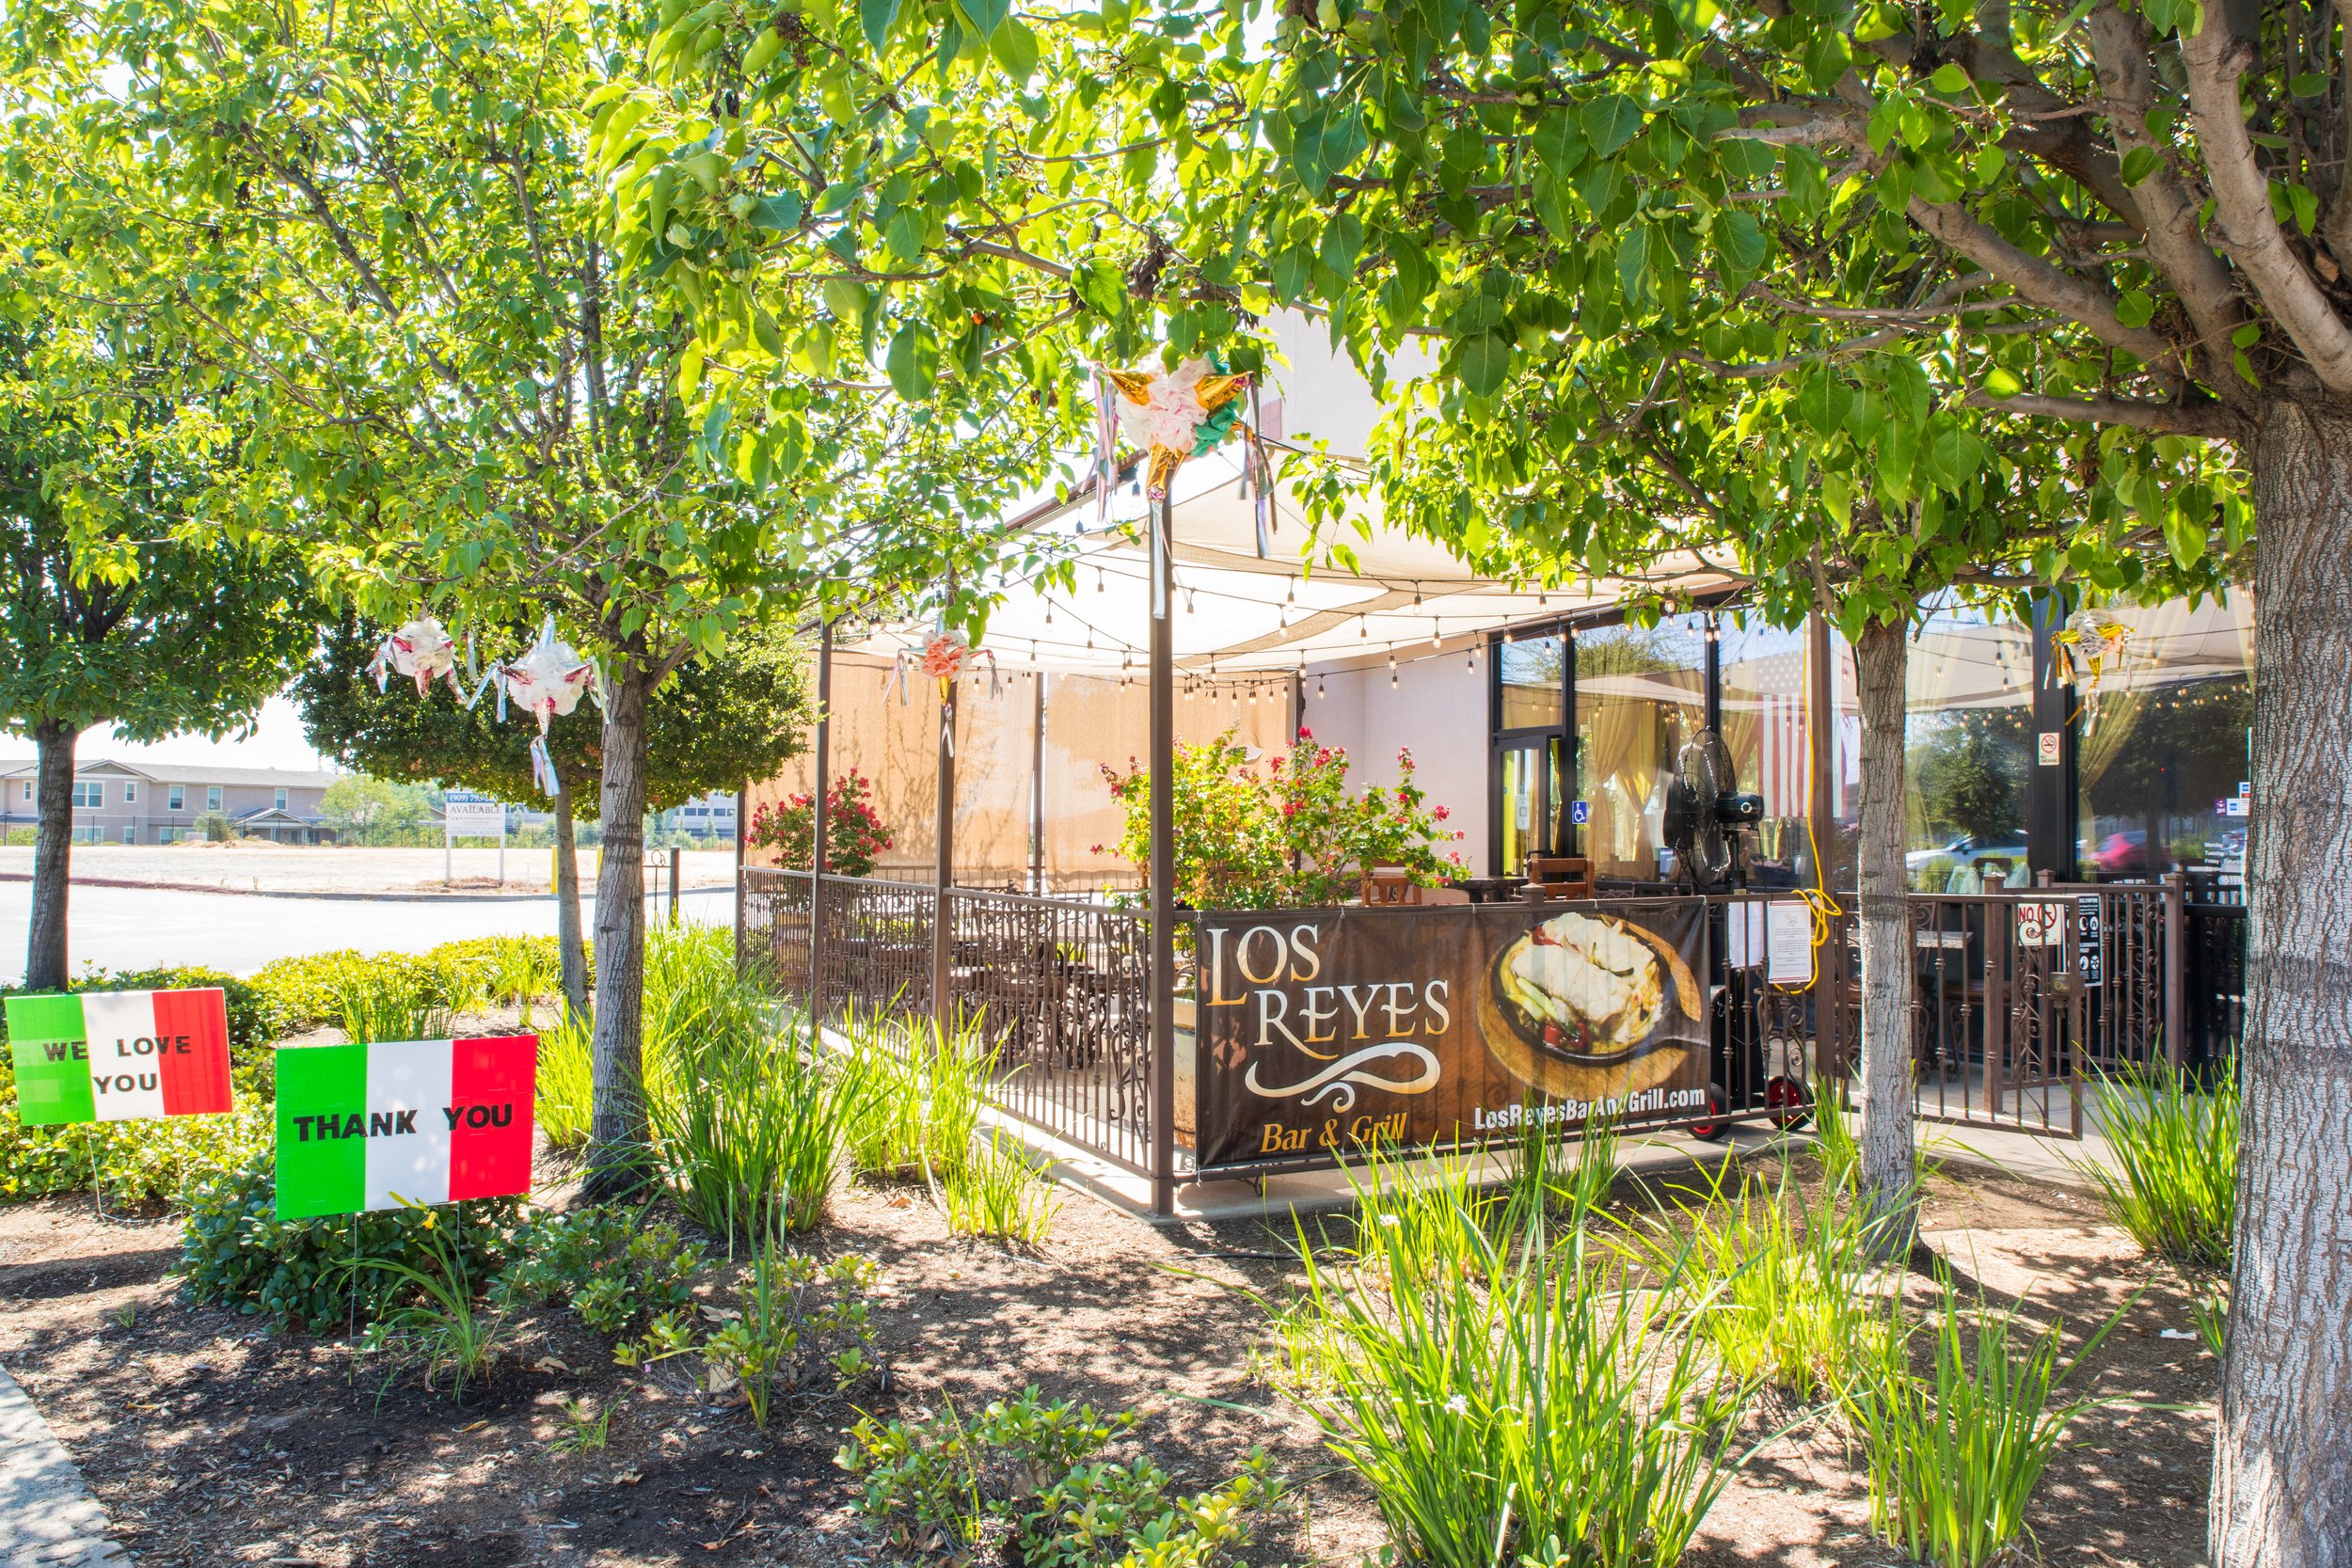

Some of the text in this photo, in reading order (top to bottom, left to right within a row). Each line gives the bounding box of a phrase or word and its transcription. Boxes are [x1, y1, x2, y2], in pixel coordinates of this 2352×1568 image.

[450, 794, 469, 802] (909)
[450, 805, 502, 814] AVAILABLE
[2018, 907, 2035, 924] NO
[1205, 924, 1321, 1006] LOS
[1253, 979, 1451, 1060] REYES
[42, 1036, 192, 1063] WE LOVE
[92, 1073, 158, 1095] YOU
[293, 1102, 513, 1142] THANK YOU
[1259, 1112, 1407, 1153] Bar & Grill
